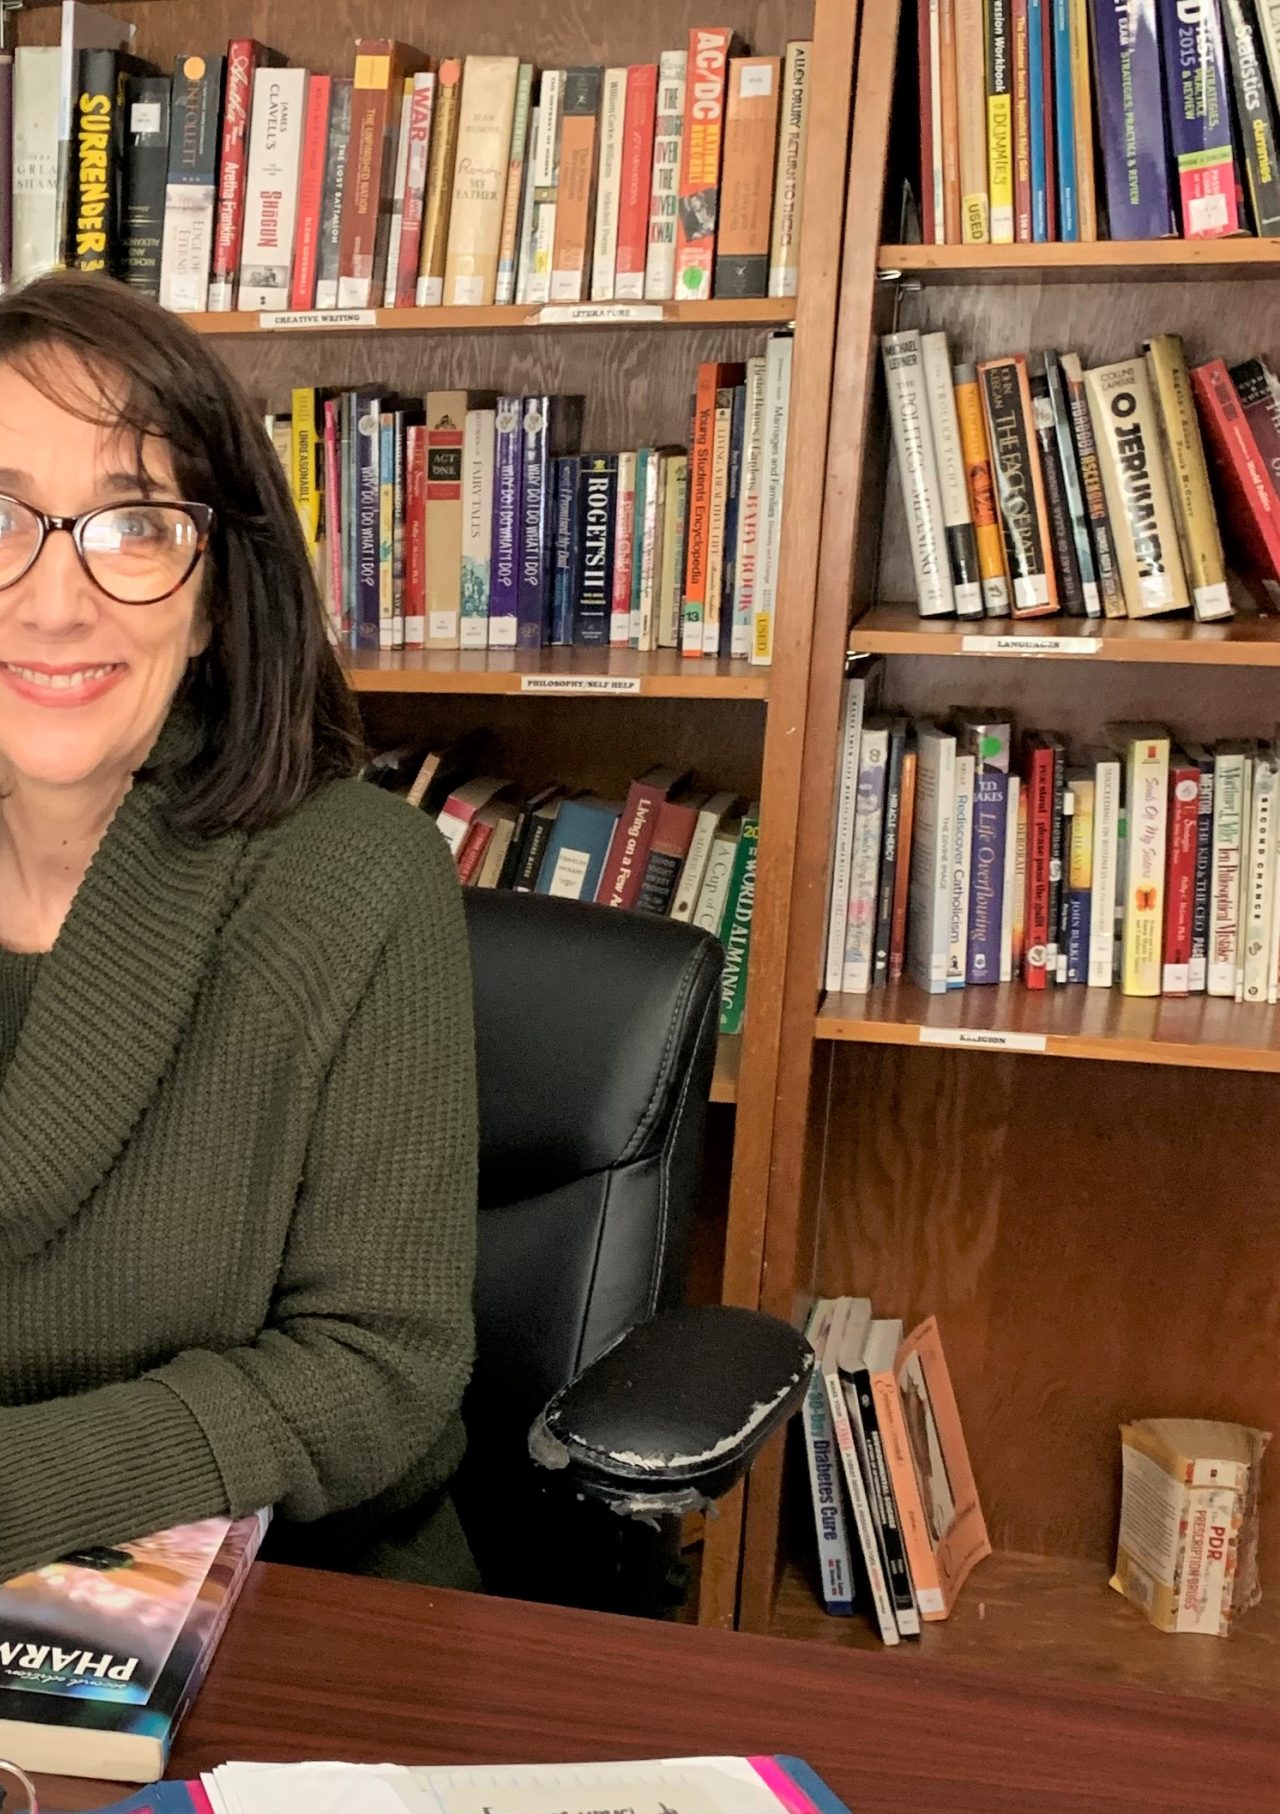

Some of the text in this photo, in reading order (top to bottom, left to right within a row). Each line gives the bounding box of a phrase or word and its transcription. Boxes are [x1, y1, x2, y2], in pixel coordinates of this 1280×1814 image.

[1017, 16, 1026, 31] The
[994, 37, 1007, 92] Workbook
[1178, 28, 1194, 67] 2015
[693, 31, 726, 120] AC/DC
[792, 48, 806, 85] ALLEN
[265, 83, 281, 151] CLAVELL'S
[279, 101, 288, 134] JAMES
[411, 87, 431, 142] WAR
[791, 89, 803, 128] DRURY
[1182, 81, 1196, 120] REVIEW
[1234, 25, 1273, 184] Statistics dummies
[785, 132, 799, 181] RETURN
[992, 112, 1009, 185] DUMMIES
[76, 92, 112, 256] SURRENDER
[1128, 170, 1139, 205] REVIEW
[219, 161, 239, 247] Aretha Franklin
[331, 144, 346, 244] THE LOST BATTALION
[358, 181, 370, 215] NATION
[456, 189, 498, 201] FATHER
[968, 203, 984, 240] USED
[275, 313, 361, 324] CREATIVE WRITING
[571, 308, 632, 319] LITERATURE
[1111, 392, 1137, 418] O
[996, 410, 1020, 452] THE
[298, 430, 310, 503] UNREASONABLE
[432, 453, 455, 465] ACT
[526, 464, 540, 488] WHY
[767, 406, 784, 518] Marriages and Families
[360, 466, 374, 489] WHY
[470, 460, 483, 495] FAIRY
[526, 489, 540, 501] DO
[1247, 459, 1272, 512] World Politics
[360, 491, 374, 504] DO
[690, 408, 711, 584] Young Students Encyclopedia
[360, 511, 374, 525] DO
[470, 500, 482, 538] TALES
[526, 509, 540, 523] DO
[585, 476, 609, 568] ROGET'S
[360, 527, 374, 554] WHAT
[525, 526, 539, 553] WHAT
[684, 610, 700, 623] 13
[757, 618, 768, 651] USED
[610, 680, 635, 691] HELP
[627, 799, 652, 836] Living
[624, 839, 637, 855] on
[1016, 822, 1026, 875] DEBORAH
[1035, 822, 1046, 857] please
[1218, 846, 1239, 862] Ten
[950, 795, 968, 944] Rediscover Catholicism
[1035, 858, 1045, 882] pass
[1254, 797, 1269, 920] SECOND CHANCE
[614, 868, 630, 893] Few
[705, 862, 727, 894] Cup
[973, 812, 997, 942] Life Overflowing
[1035, 884, 1046, 900] the
[706, 898, 717, 910] of
[1070, 899, 1081, 927] JOHN
[720, 859, 757, 1009] WORLD ALMANAC
[813, 1440, 836, 1505] Diabetes
[819, 1506, 838, 1540] Cure
[1187, 1509, 1207, 1574] PRESCRIPTION
[1206, 1524, 1226, 1561] PDR
[4, 1669, 66, 1685] edition
